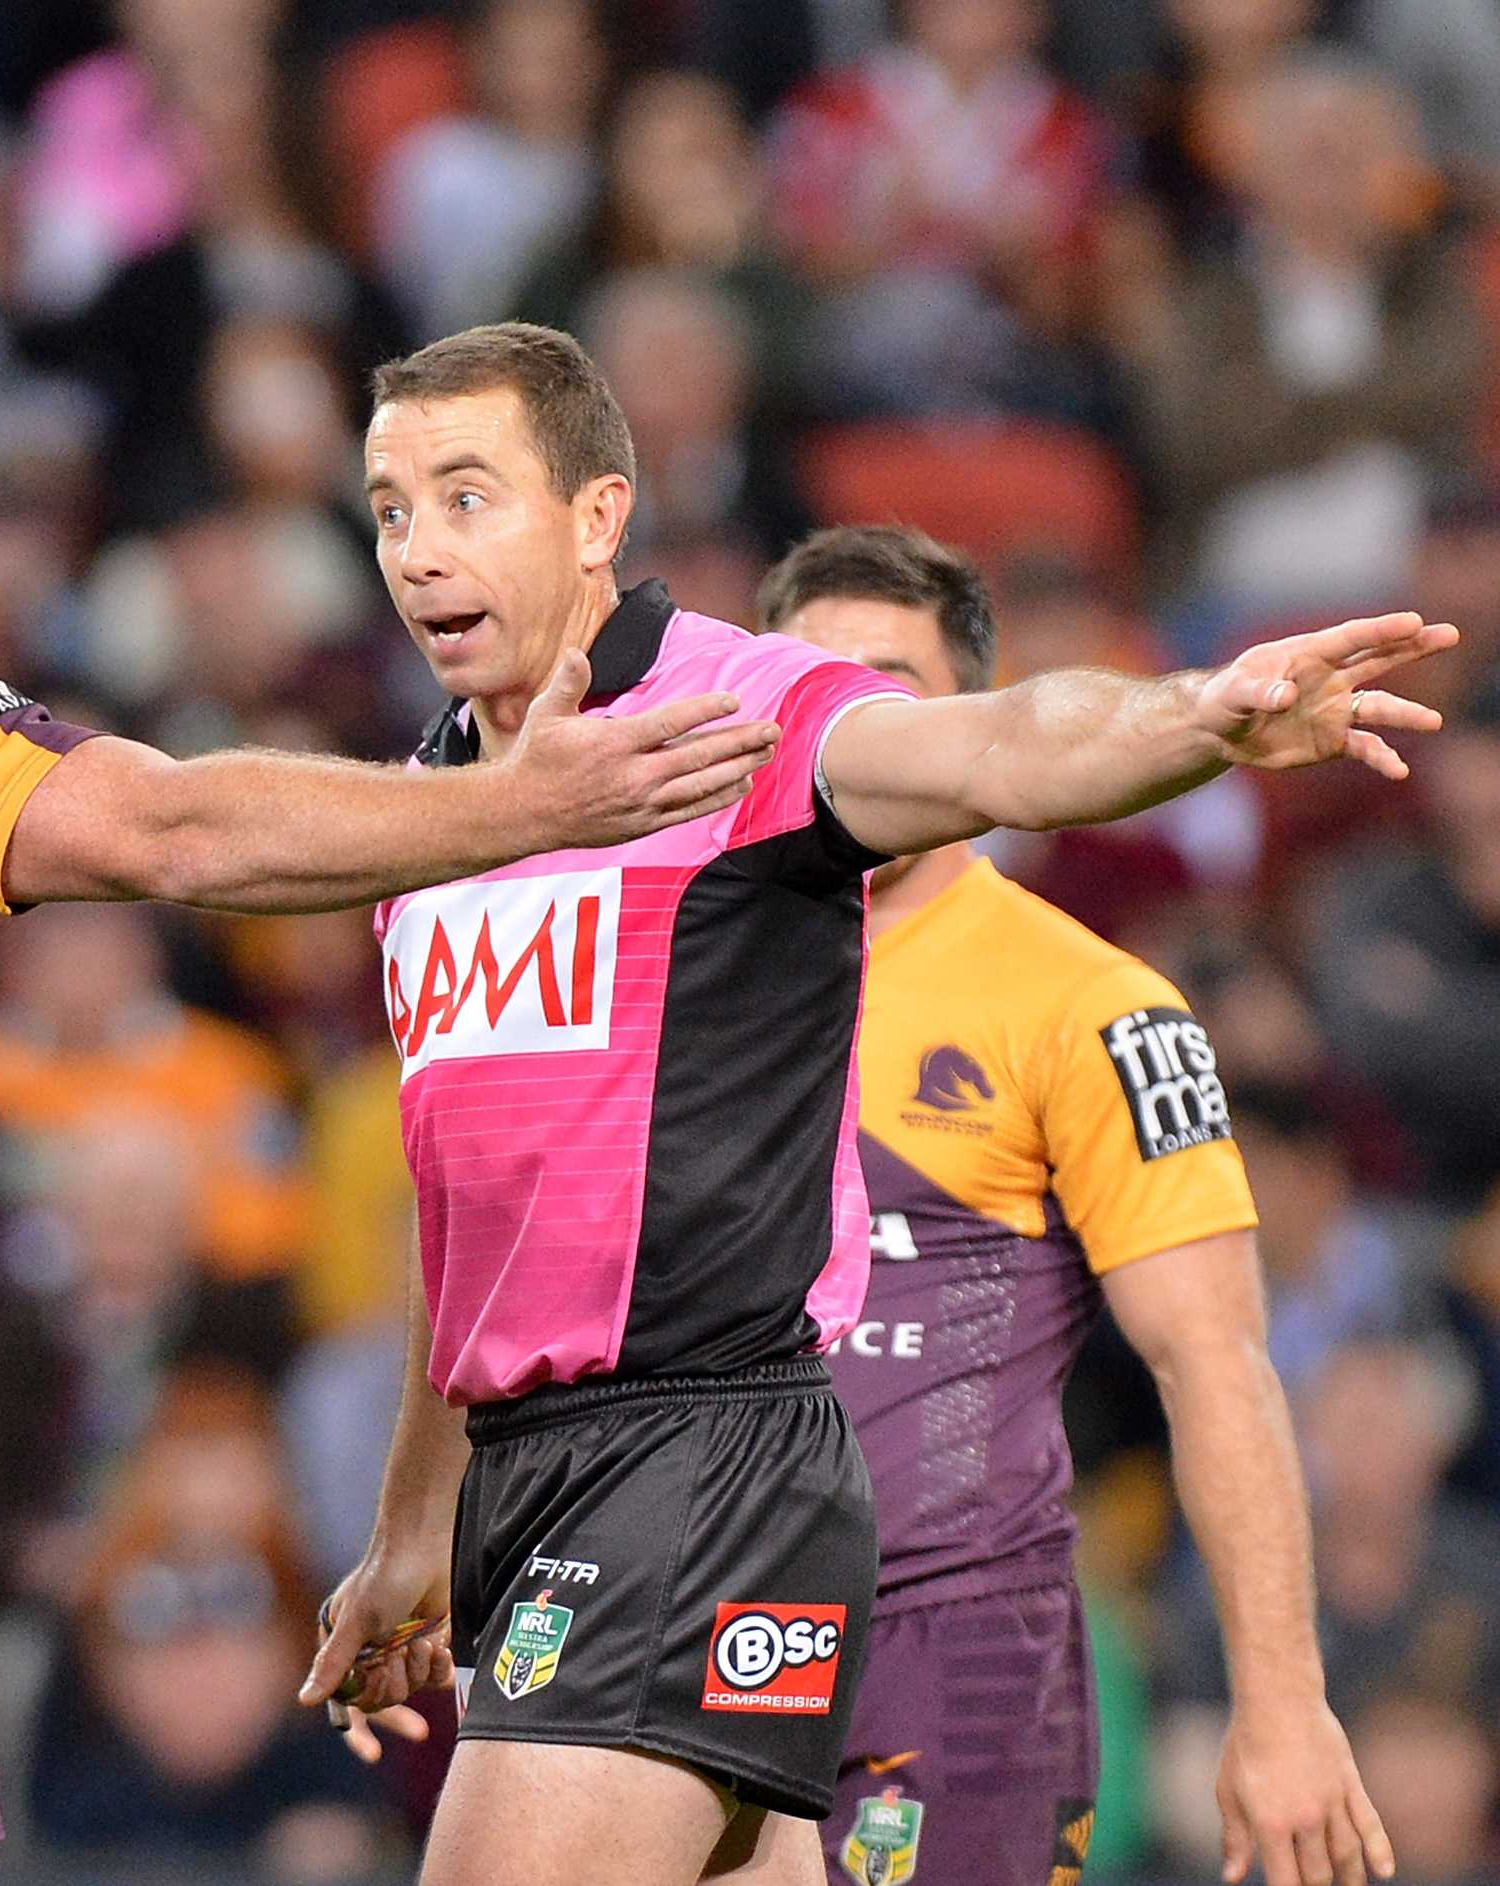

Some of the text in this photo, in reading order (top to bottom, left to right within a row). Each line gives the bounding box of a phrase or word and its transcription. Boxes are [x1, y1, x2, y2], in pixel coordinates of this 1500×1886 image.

[1109, 1009, 1218, 1091] firs
[1139, 1072, 1232, 1141] ma
[516, 1611, 559, 1637] NRL
[704, 1691, 831, 1711] COMPRESSION
